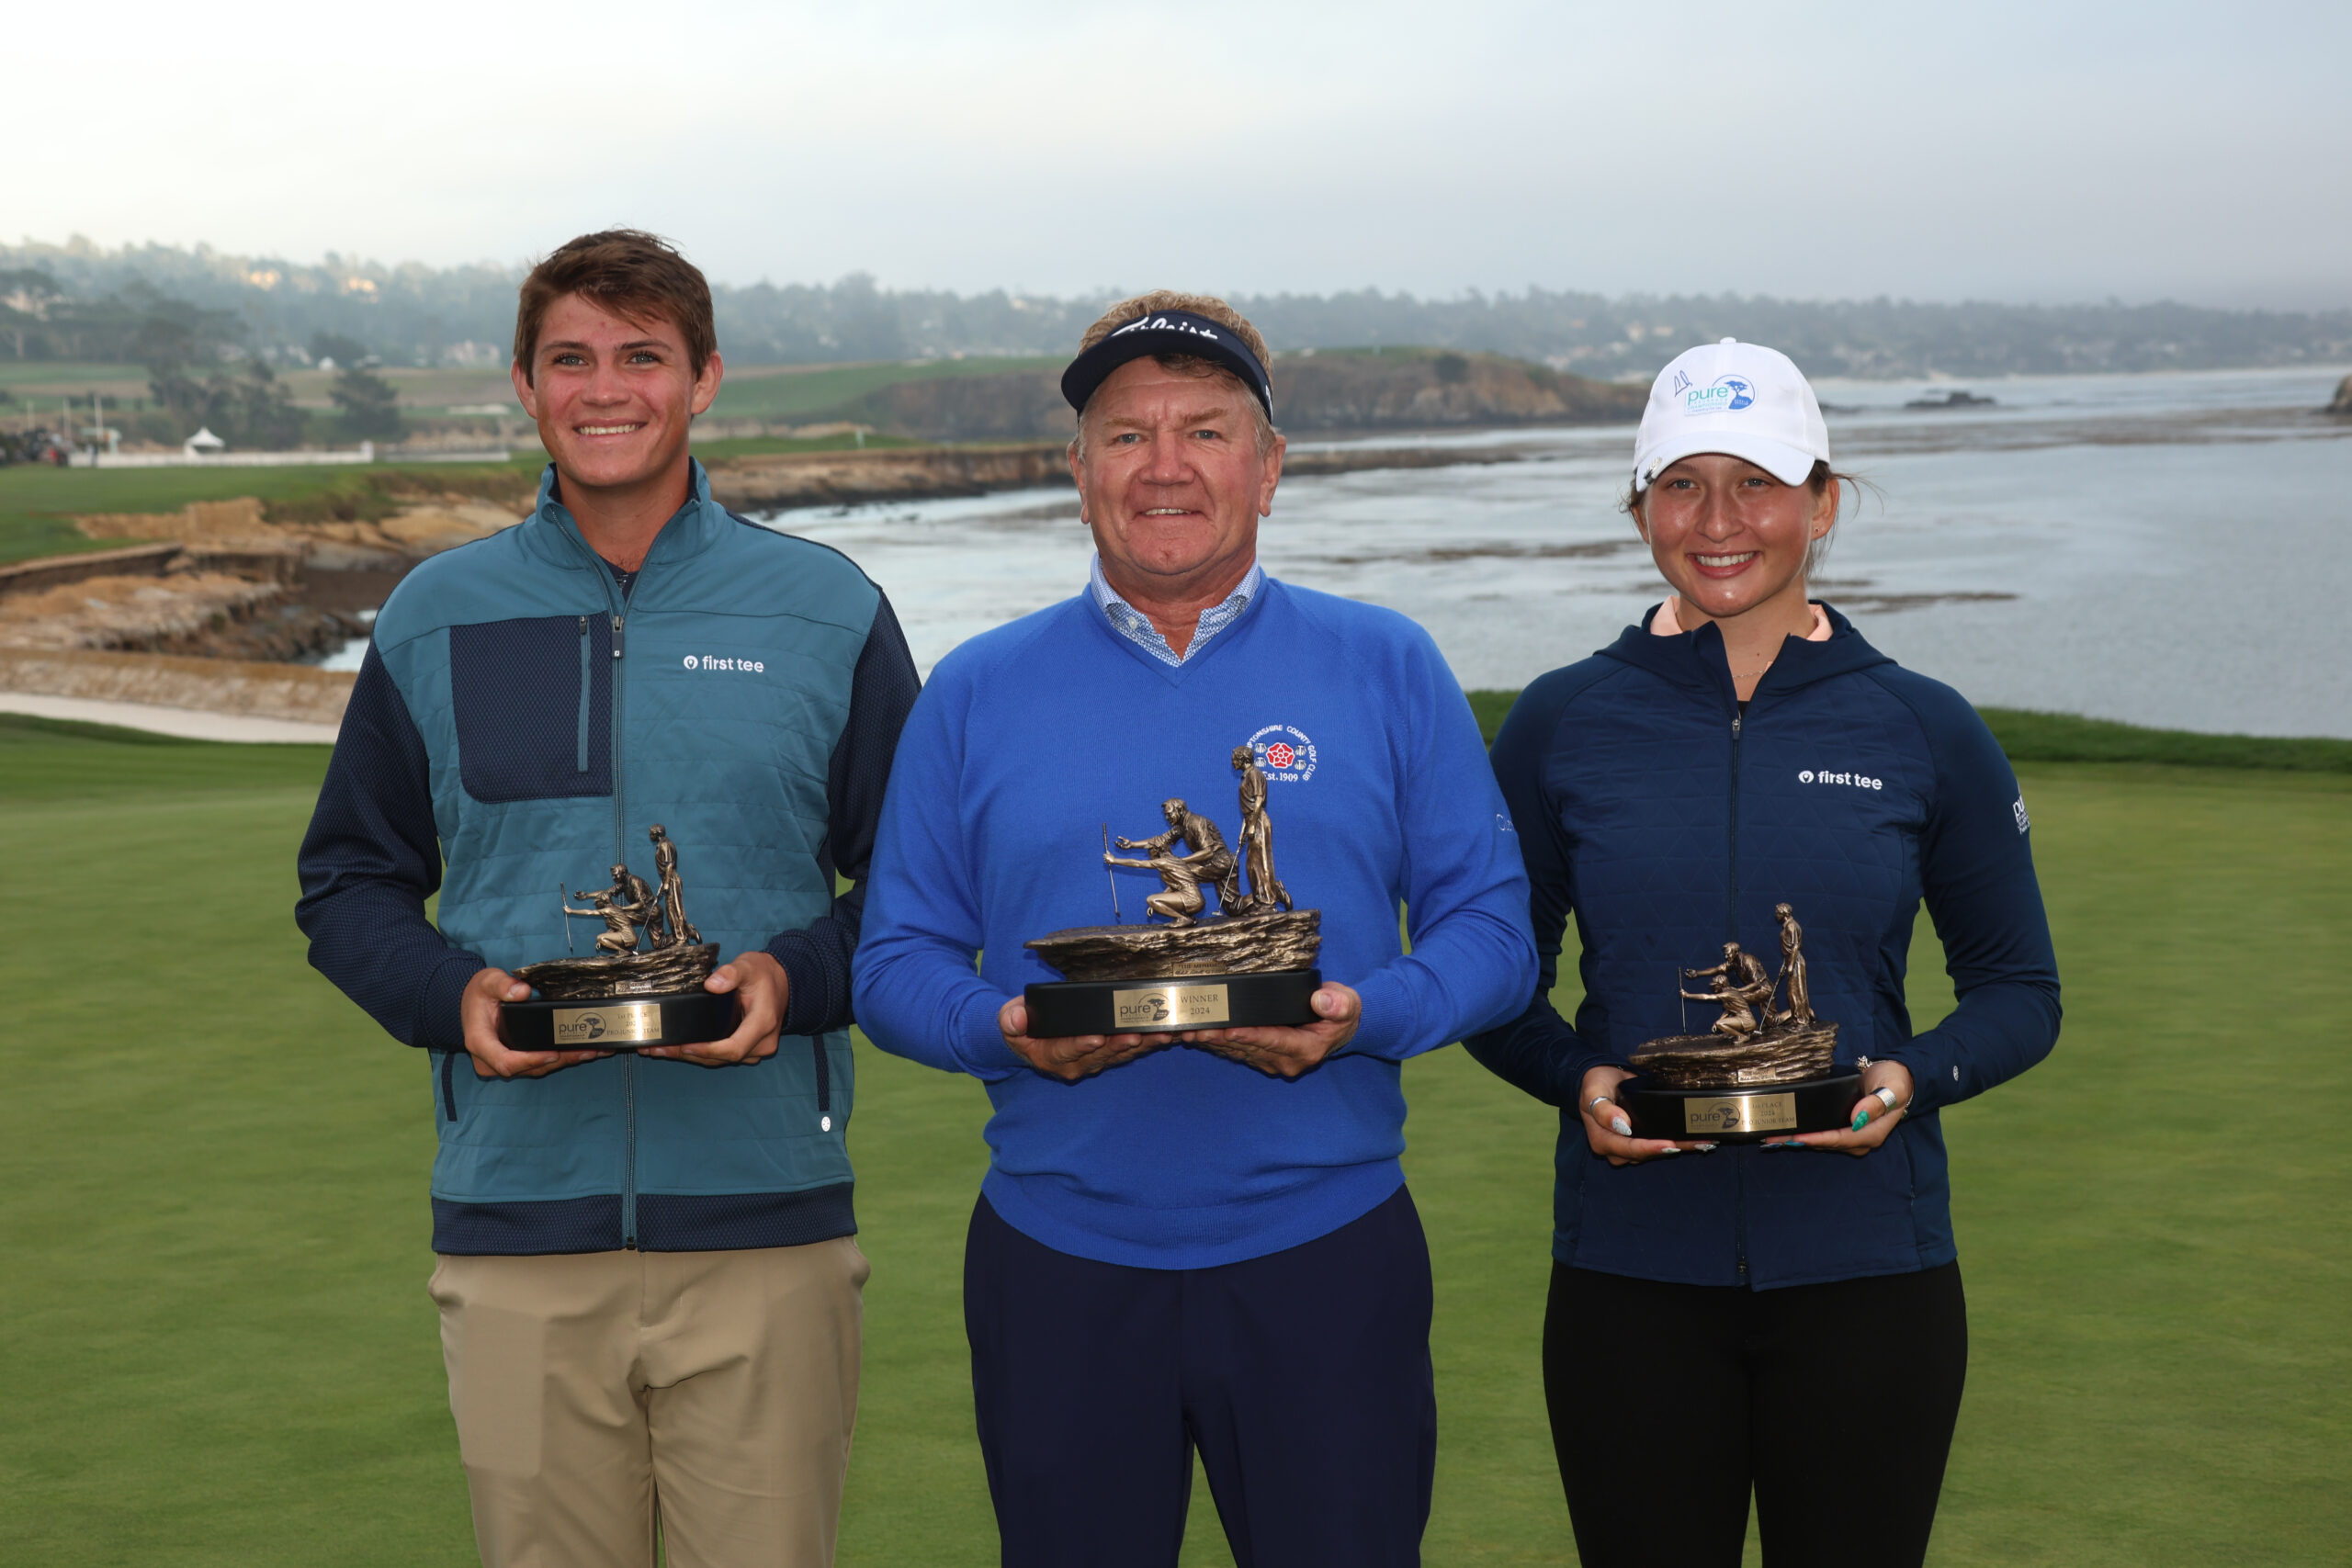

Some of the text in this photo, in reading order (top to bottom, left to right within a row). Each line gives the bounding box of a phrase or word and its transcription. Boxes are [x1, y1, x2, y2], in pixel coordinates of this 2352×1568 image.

[1688, 386, 1728, 405] pure
[702, 655, 764, 672] first tee
[1286, 726, 1311, 744] COUNTY
[1307, 745, 1317, 763] GOLF
[1302, 764, 1316, 781] CLUB
[1818, 770, 1883, 790] first tee
[1181, 994, 1219, 1004] WINNER
[1119, 1004, 1151, 1017] pure
[1190, 1007, 1211, 1015] 2024
[559, 1022, 587, 1035] pure
[1690, 1112, 1720, 1124] pure
